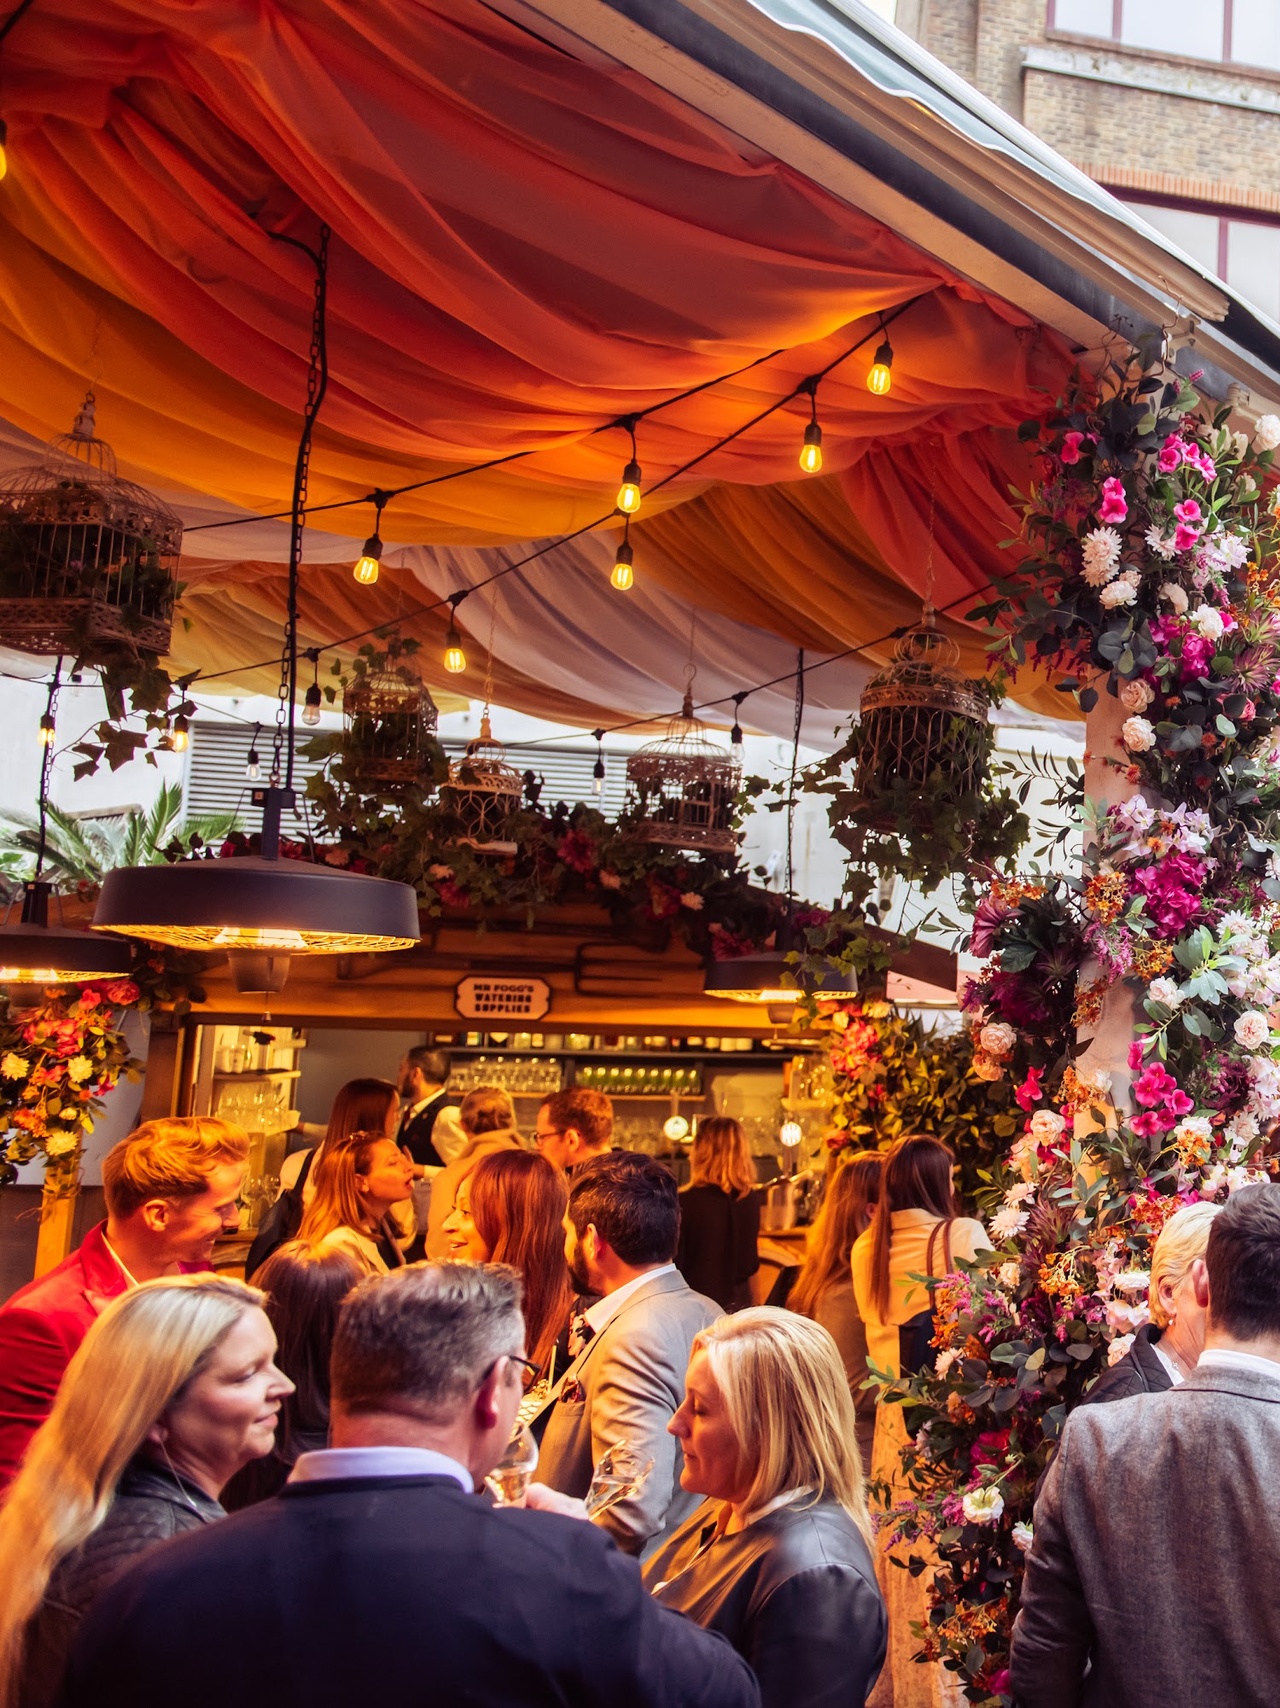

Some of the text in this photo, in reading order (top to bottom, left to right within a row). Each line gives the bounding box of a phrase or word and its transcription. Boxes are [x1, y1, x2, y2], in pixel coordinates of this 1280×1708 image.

[494, 984, 534, 992] FOGG'S
[475, 994, 531, 1003] WATERING
[475, 1004, 530, 1013] SUPPLIES
